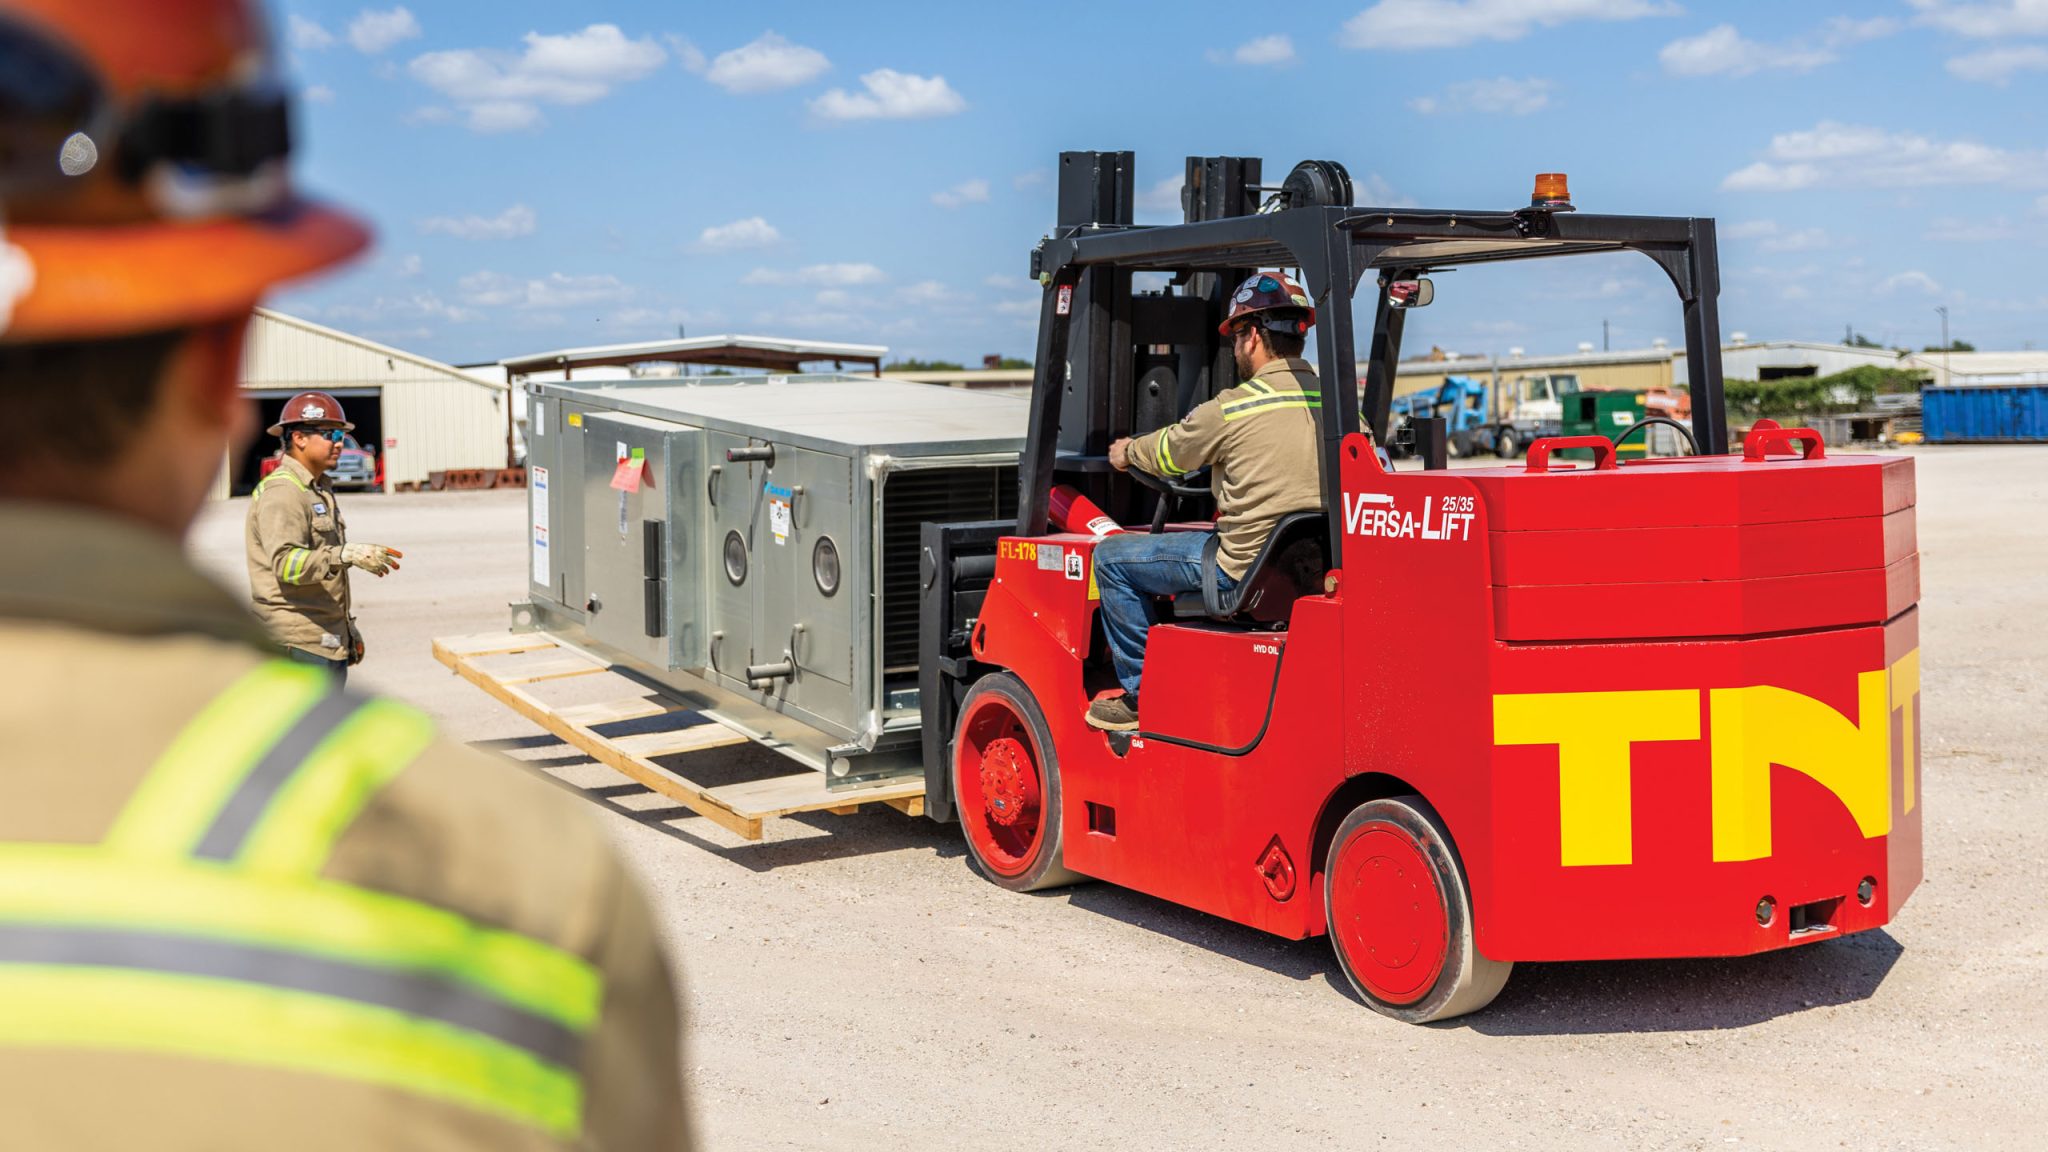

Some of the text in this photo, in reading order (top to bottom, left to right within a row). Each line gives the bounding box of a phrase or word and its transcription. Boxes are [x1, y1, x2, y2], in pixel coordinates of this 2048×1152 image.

[1441, 496, 1474, 512] 25/35
[1343, 492, 1475, 541] VERSA-LIFT
[1000, 541, 1036, 560] FL-178
[1253, 643, 1279, 655] HYD OIL
[1131, 739, 1144, 749] GAS
